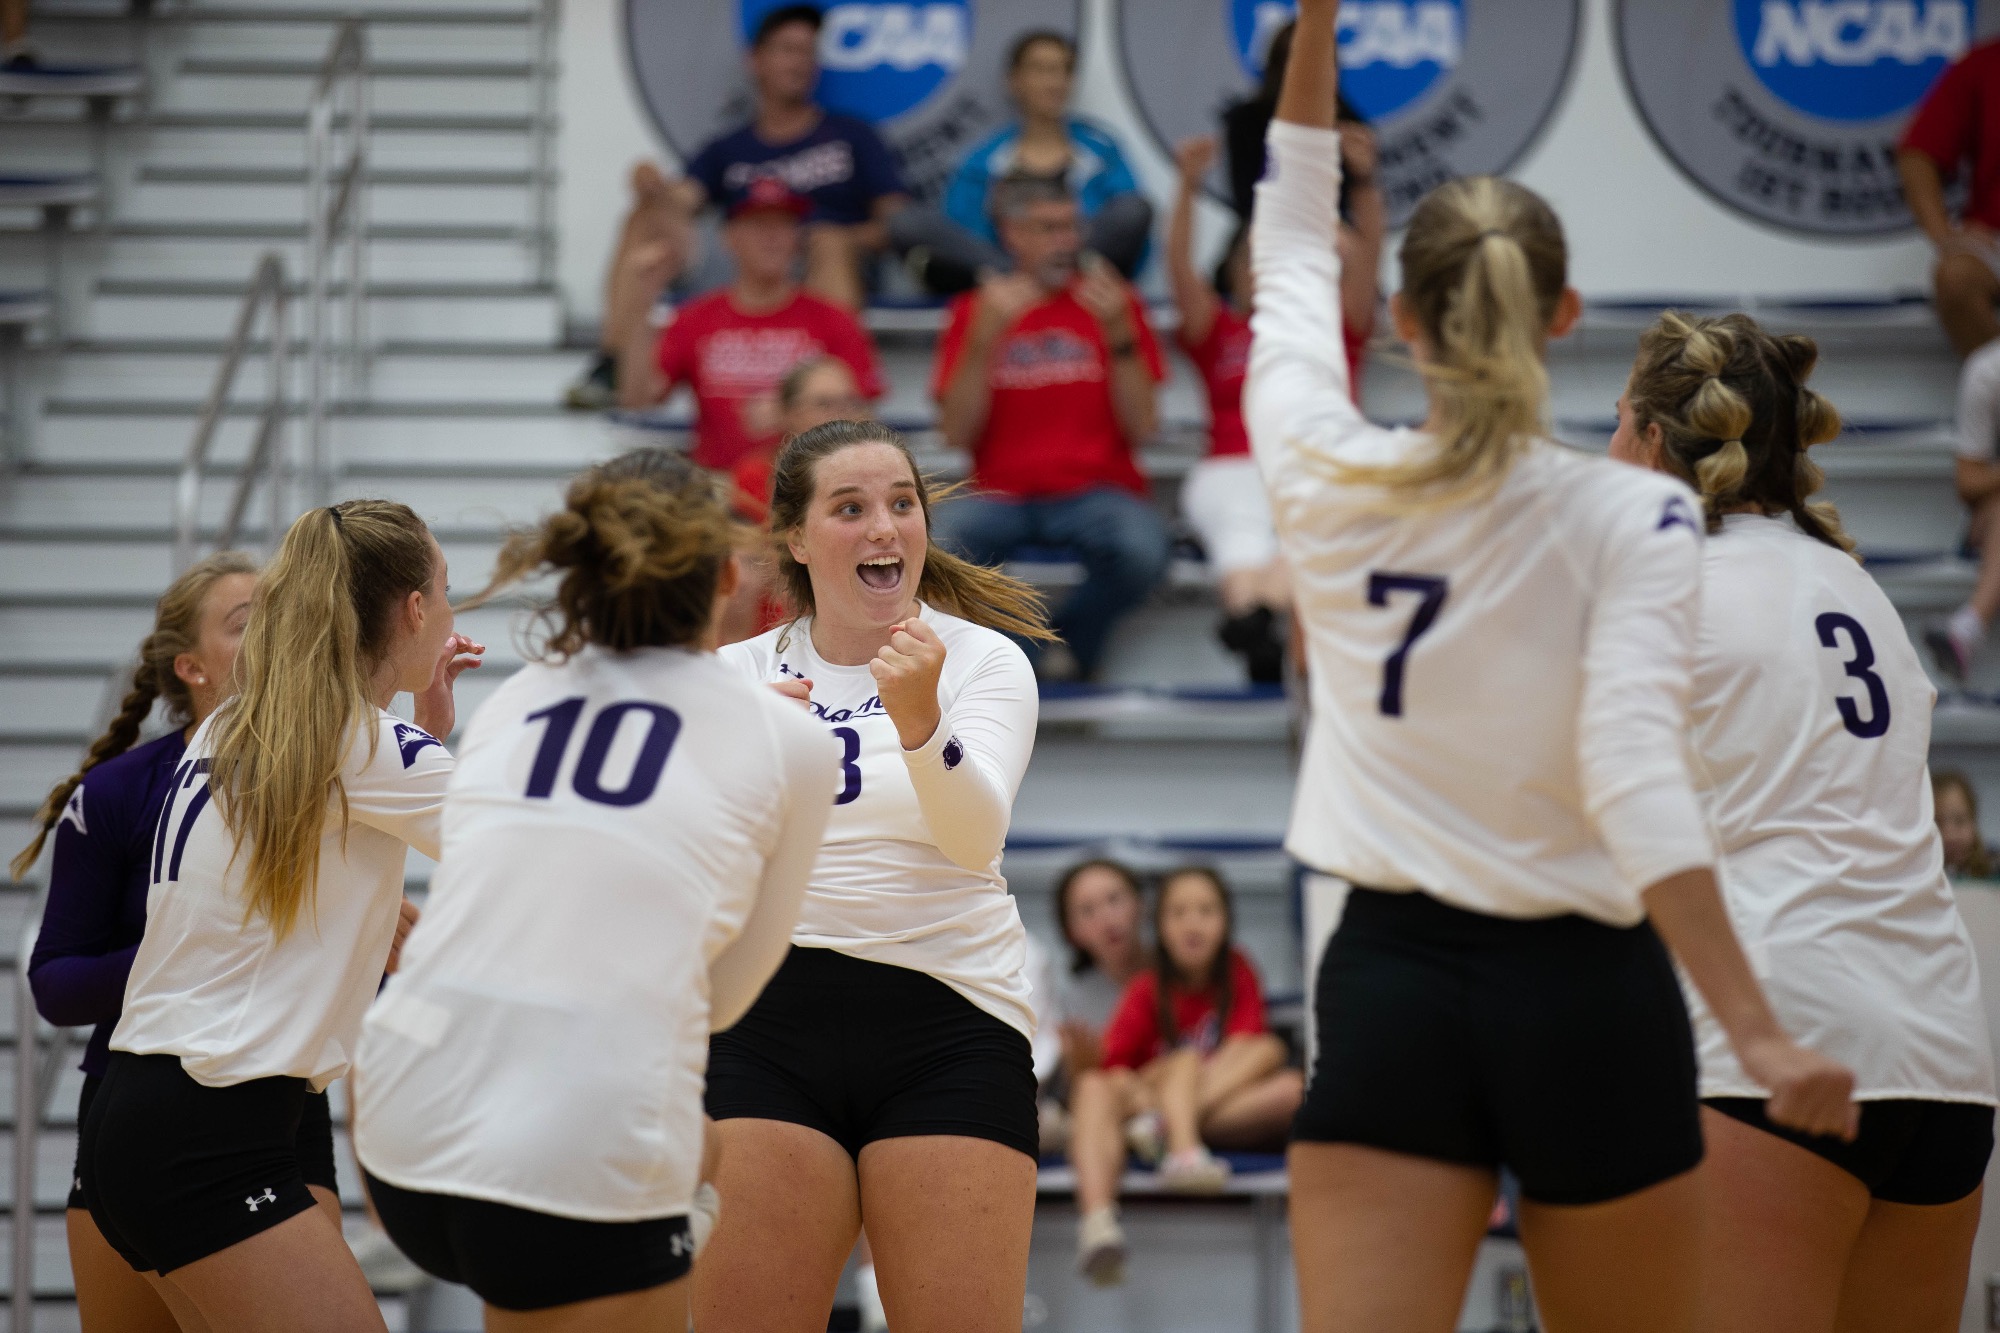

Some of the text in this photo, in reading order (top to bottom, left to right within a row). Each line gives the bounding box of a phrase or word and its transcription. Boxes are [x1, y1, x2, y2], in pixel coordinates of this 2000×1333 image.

[818, 2, 968, 71] CAA
[1752, 0, 1969, 67] NCAA
[1366, 570, 1448, 717] 7
[1815, 611, 1891, 739] 3
[525, 696, 682, 808] 10
[153, 757, 238, 885] 17
